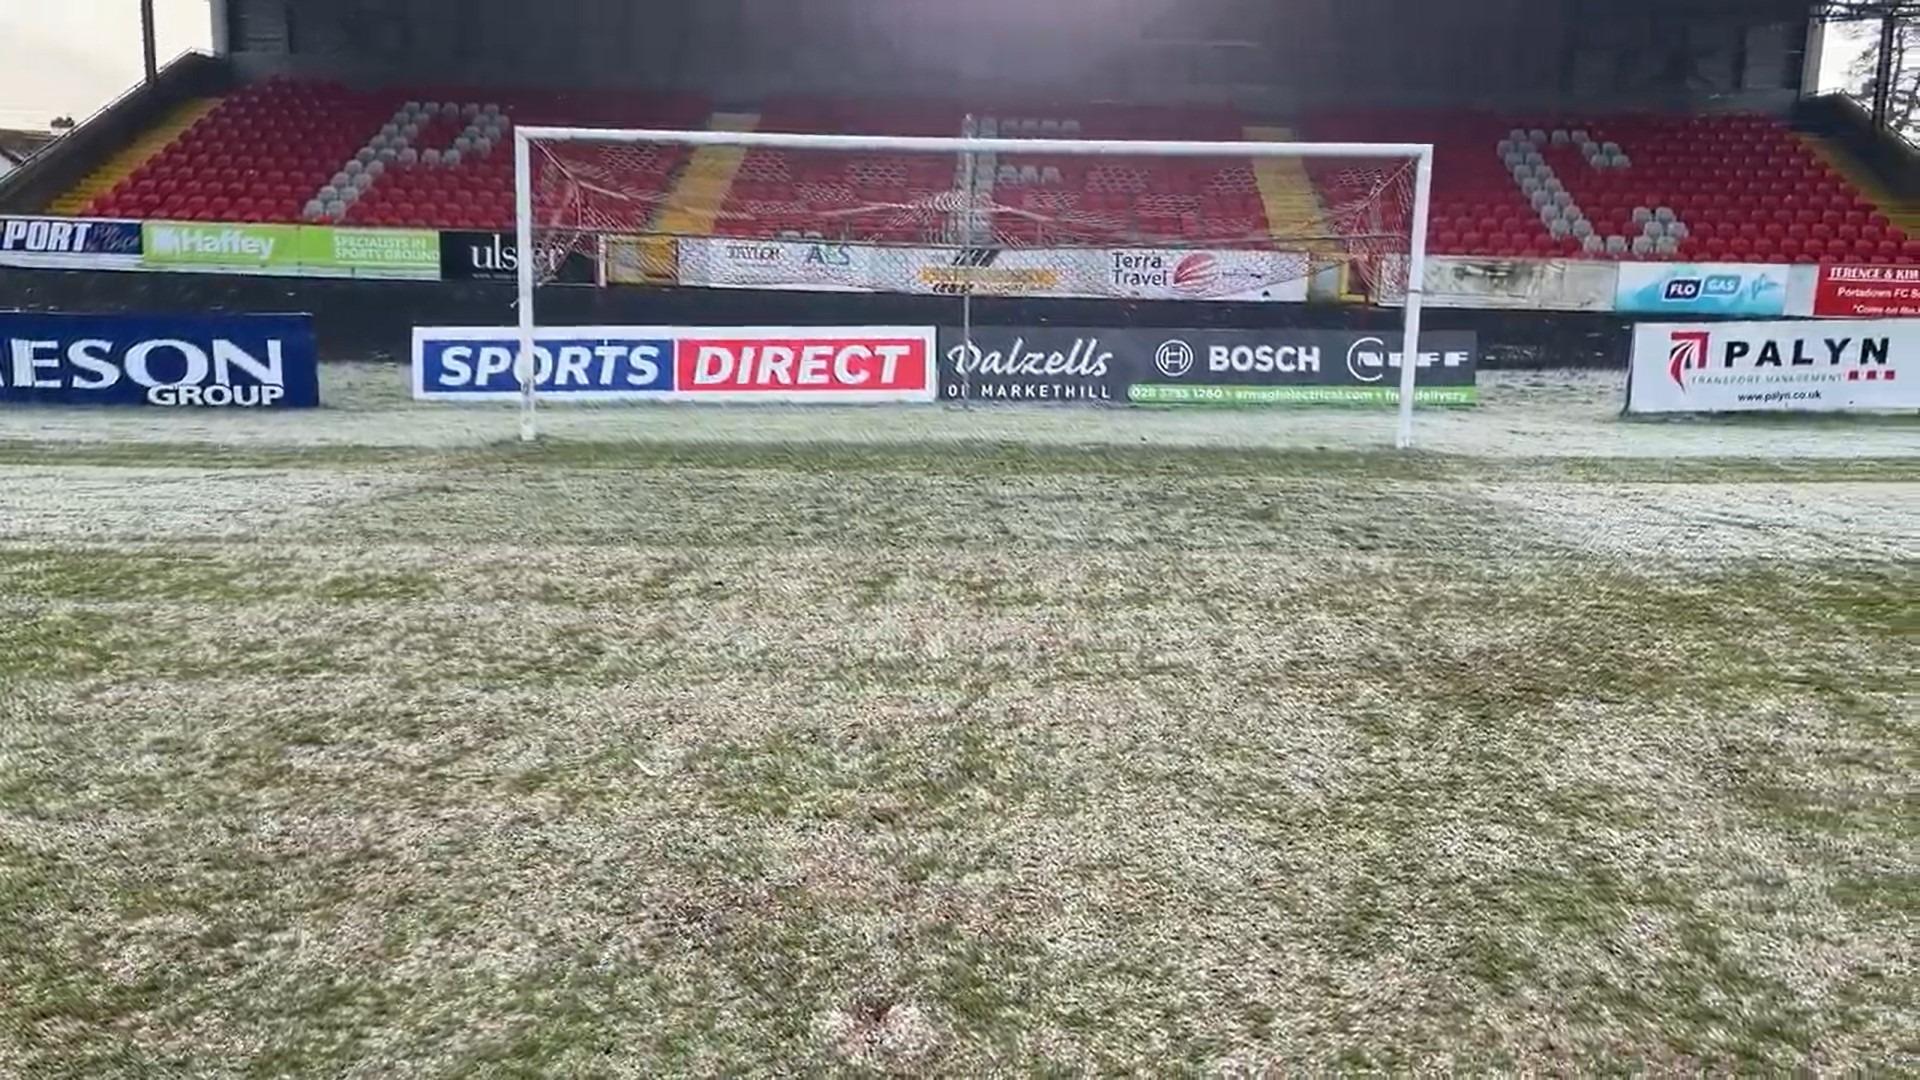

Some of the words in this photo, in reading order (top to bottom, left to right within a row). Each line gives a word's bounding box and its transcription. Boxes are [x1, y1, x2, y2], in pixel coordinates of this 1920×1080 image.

[0, 220, 92, 251] PORT
[335, 236, 410, 250] SPECIALISTS
[412, 238, 427, 251] IN
[181, 228, 275, 261] Haffey
[384, 248, 439, 261] GROUND
[1113, 252, 1162, 269] Terra
[1113, 269, 1167, 286] Travel
[1831, 266, 1879, 278] TERENCE
[1884, 268, 1892, 279] &
[1669, 283, 1696, 296] FLO
[1707, 278, 1736, 291] GAS
[1837, 286, 1892, 297] Portadown
[1894, 288, 1909, 298] FC
[947, 336, 1113, 376] Dalzells
[1209, 345, 1320, 372] BOSCH
[1725, 338, 1889, 368] PALYN
[0, 339, 284, 388] ESON
[438, 345, 660, 386] SPORTS
[694, 345, 910, 384] DIRECT
[1692, 374, 1760, 385] TRANSPORT
[1766, 373, 1843, 384] MANAGEMENT
[148, 385, 284, 406] GROUP
[981, 384, 1111, 398] MARKETHILL
[1414, 389, 1468, 403] delivery
[1738, 389, 1821, 402] www.palyn.co.uk
